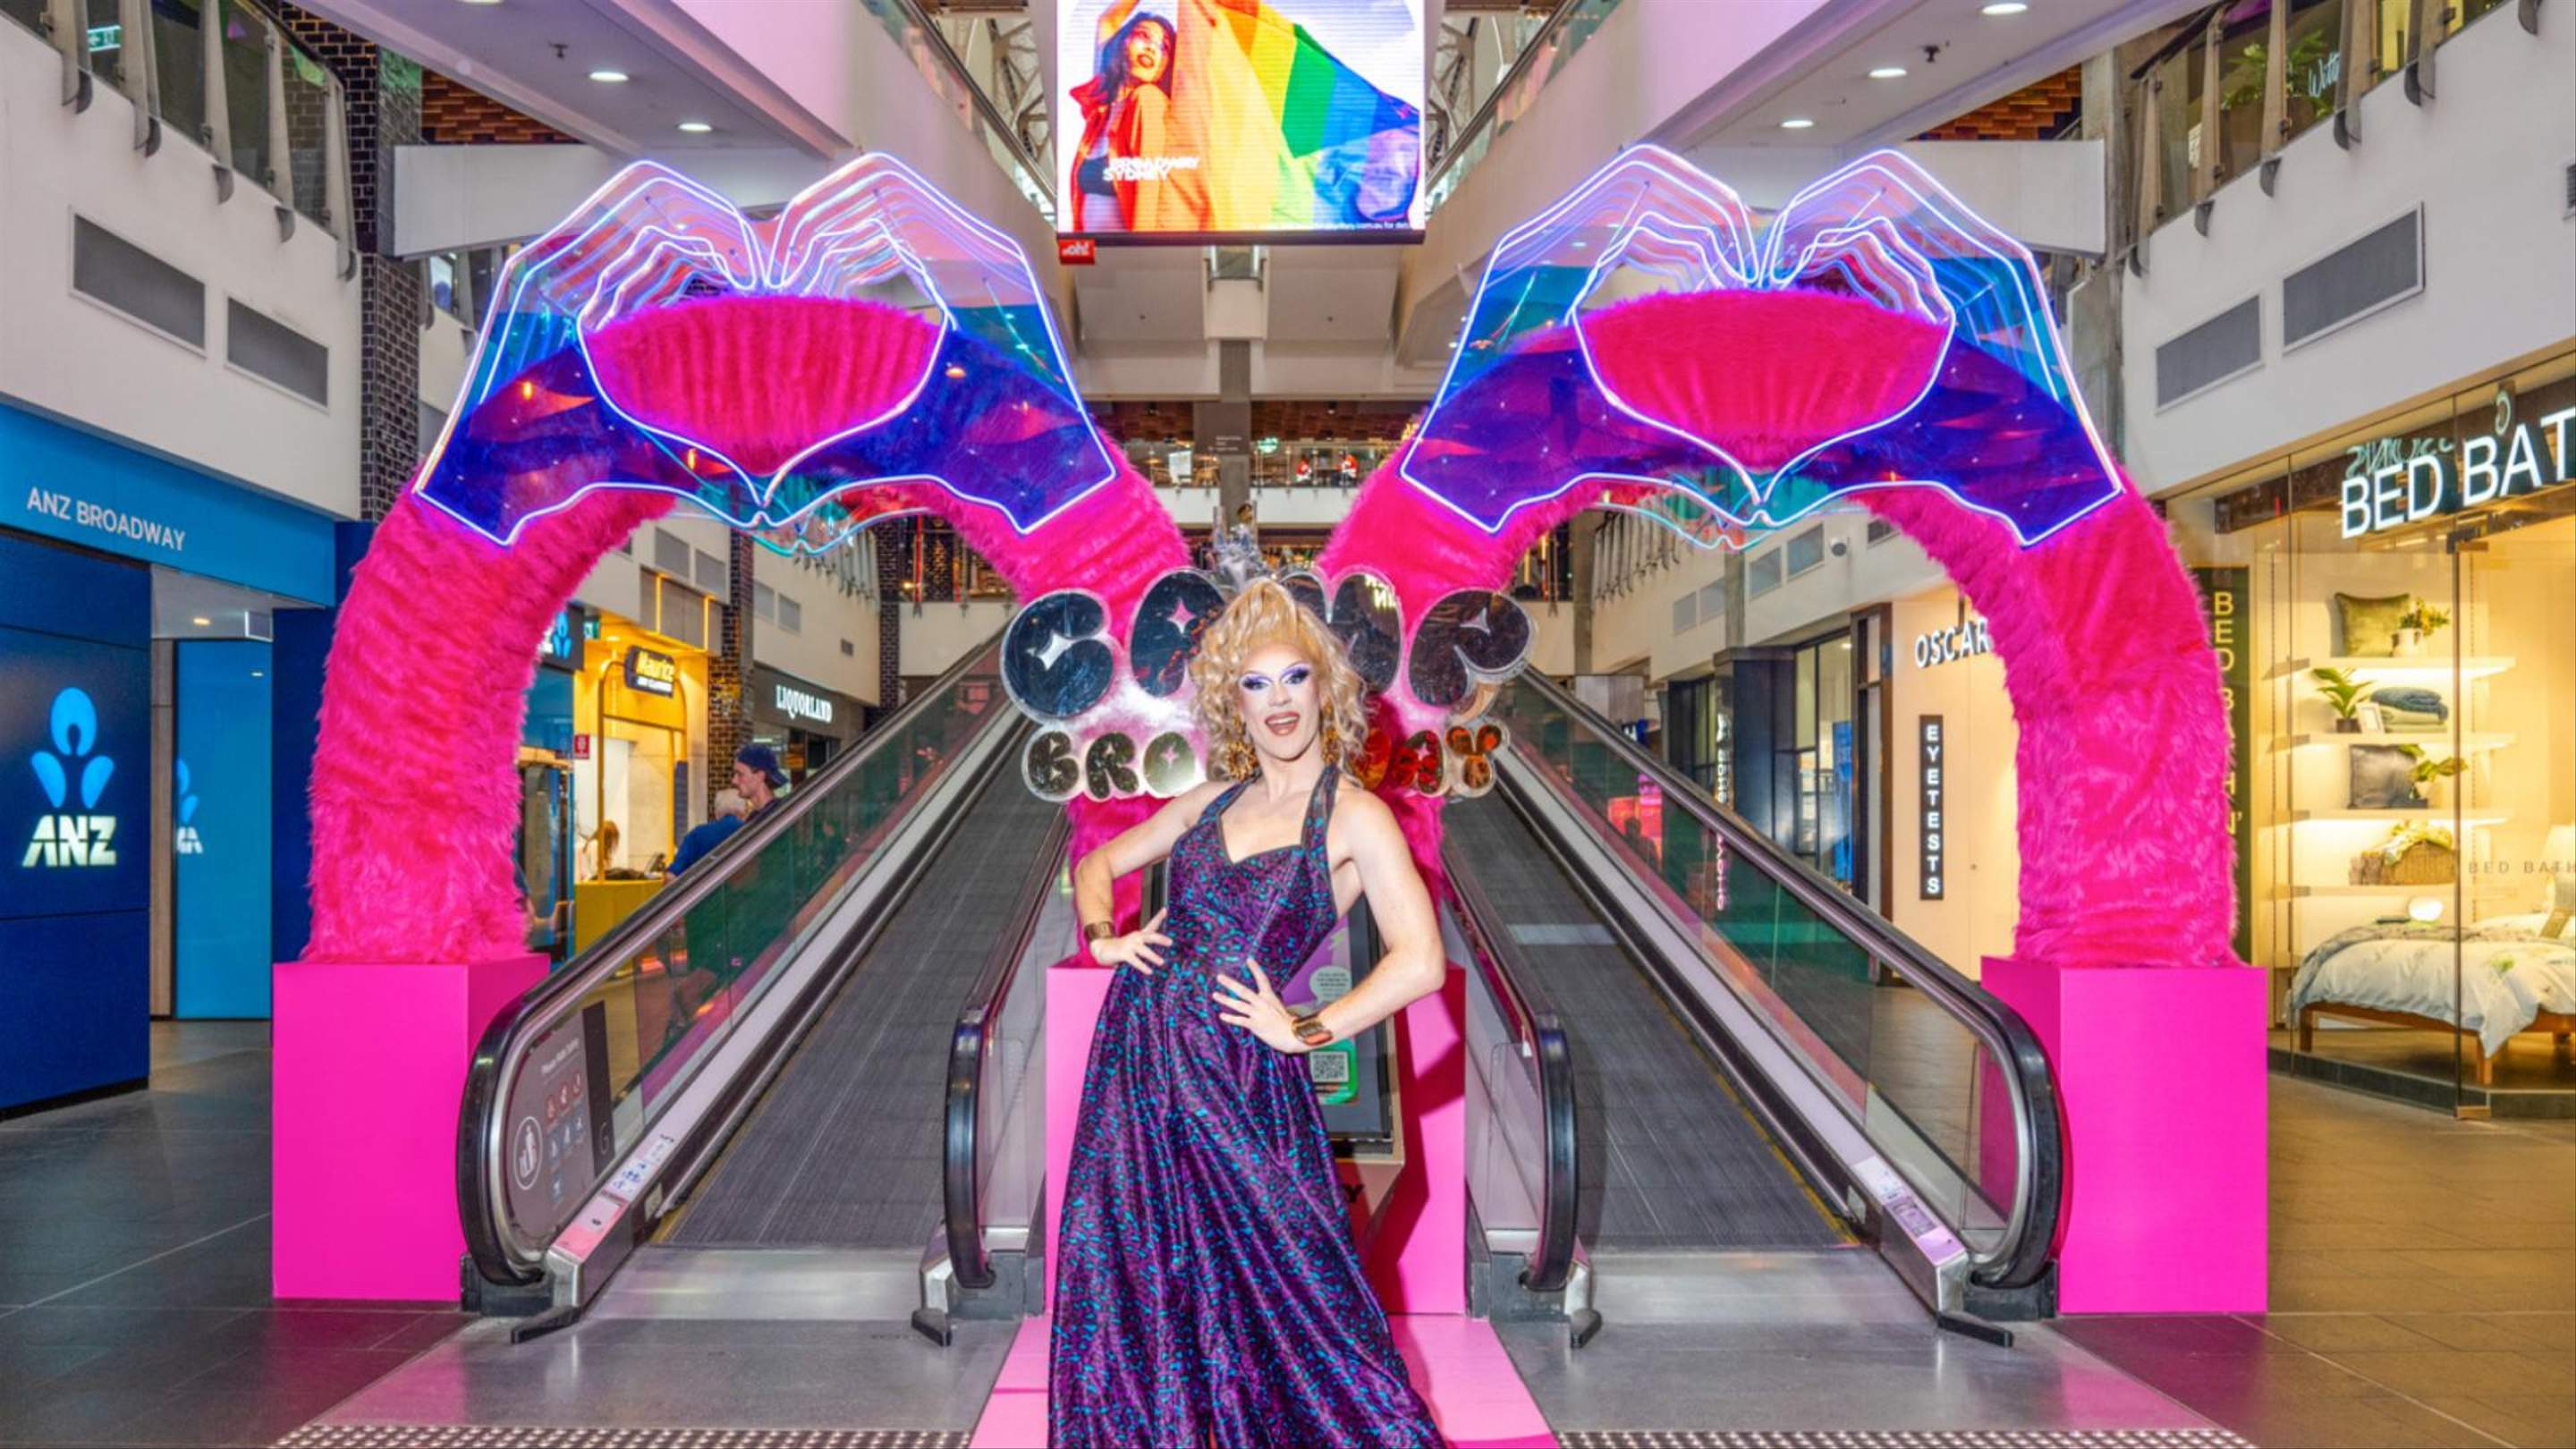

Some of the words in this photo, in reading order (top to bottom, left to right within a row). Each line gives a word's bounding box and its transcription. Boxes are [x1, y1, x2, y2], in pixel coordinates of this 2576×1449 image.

[1103, 167, 1169, 182] SYDNEY
[27, 487, 71, 521] ANZ
[76, 501, 185, 551] BROADWAY
[2341, 453, 2443, 538] BED
[1916, 614, 1991, 668] OSCAR
[775, 684, 833, 724] LIQUORLAND
[1022, 720, 1508, 799] BROAY
[21, 815, 116, 867] ANZ
[2469, 861, 2510, 874] BED
